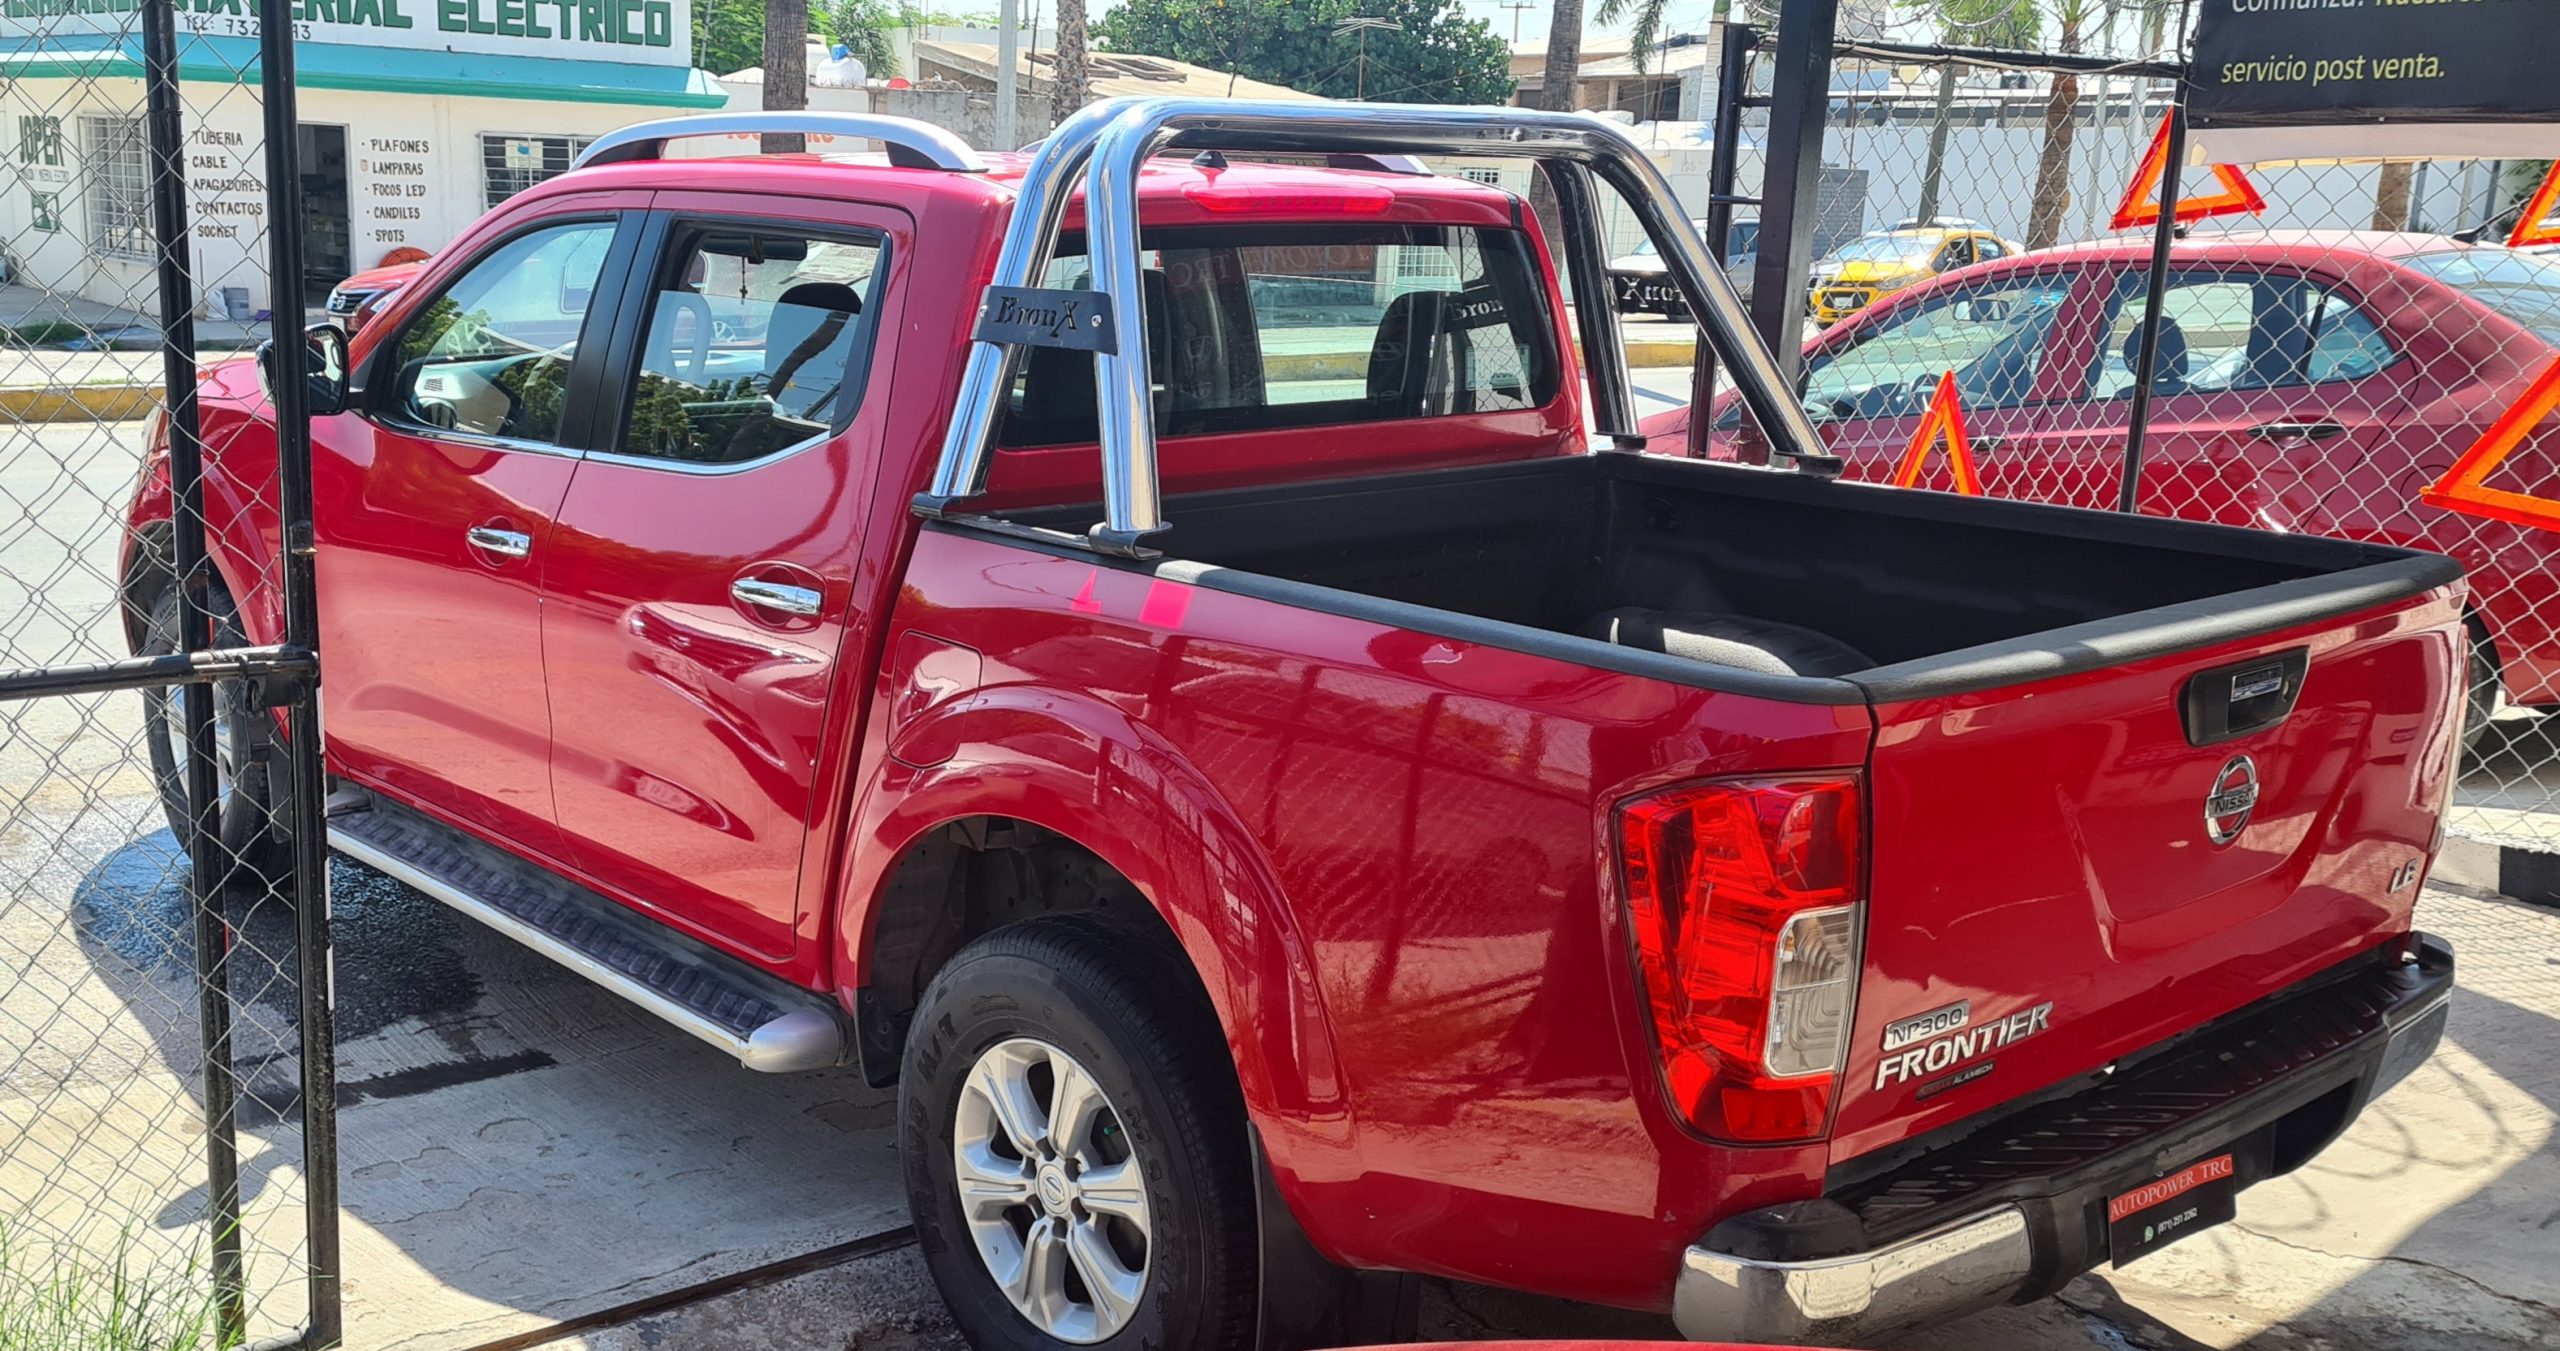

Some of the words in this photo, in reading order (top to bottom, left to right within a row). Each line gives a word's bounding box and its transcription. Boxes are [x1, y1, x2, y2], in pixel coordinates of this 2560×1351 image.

[185, 15, 215, 31] TEL:
[438, 0, 672, 47] ELECTRICO
[2220, 54, 2307, 84] servicio
[2312, 54, 2366, 87] post
[2372, 53, 2446, 80] venta.
[192, 131, 243, 146] TUBERIA
[370, 139, 430, 154] PLAFONES
[192, 155, 228, 169] CABLE
[372, 161, 424, 176] LAMPARAS
[193, 178, 263, 192] APAGADORES
[372, 183, 402, 196] FOCOS
[406, 184, 426, 197] LED
[195, 201, 264, 216] CONTACTOS
[374, 206, 421, 220] CANDILES
[197, 224, 239, 238] SOCKET
[375, 229, 405, 242] SPOTS
[994, 296, 1078, 338] BronX
[2388, 858, 2417, 894] LE
[1891, 1007, 1964, 1047] NP300
[1874, 1001, 2054, 1091] FRONTIER
[2111, 1172, 2195, 1218] AUTOPOWER
[2201, 1158, 2232, 1180] TRC
